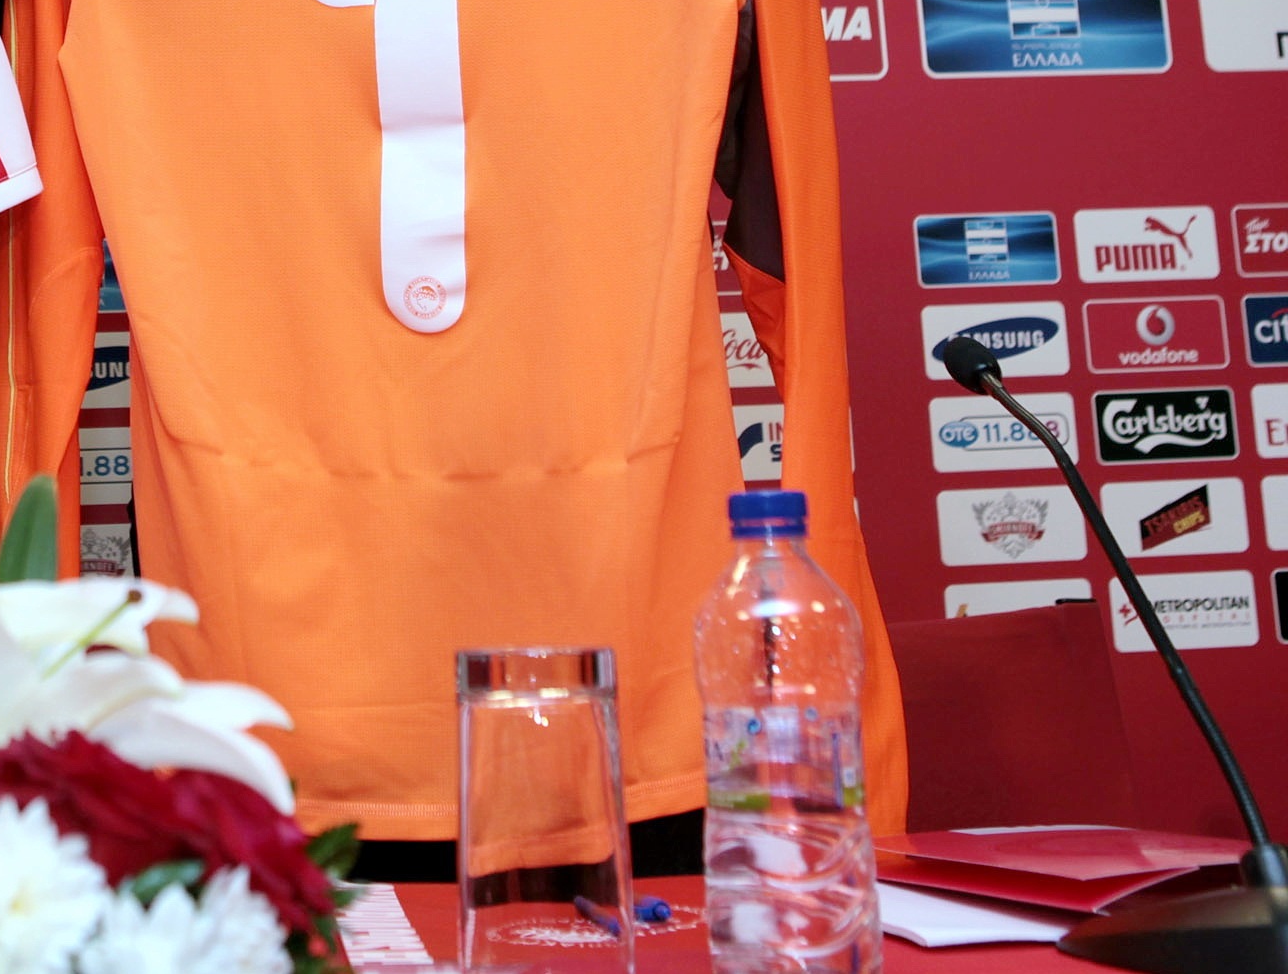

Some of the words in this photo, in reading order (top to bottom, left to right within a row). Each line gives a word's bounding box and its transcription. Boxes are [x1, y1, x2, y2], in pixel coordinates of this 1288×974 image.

[1094, 243, 1177, 272] PUMA
[1118, 347, 1199, 365] vodafone
[1103, 397, 1227, 446] Carlsberg
